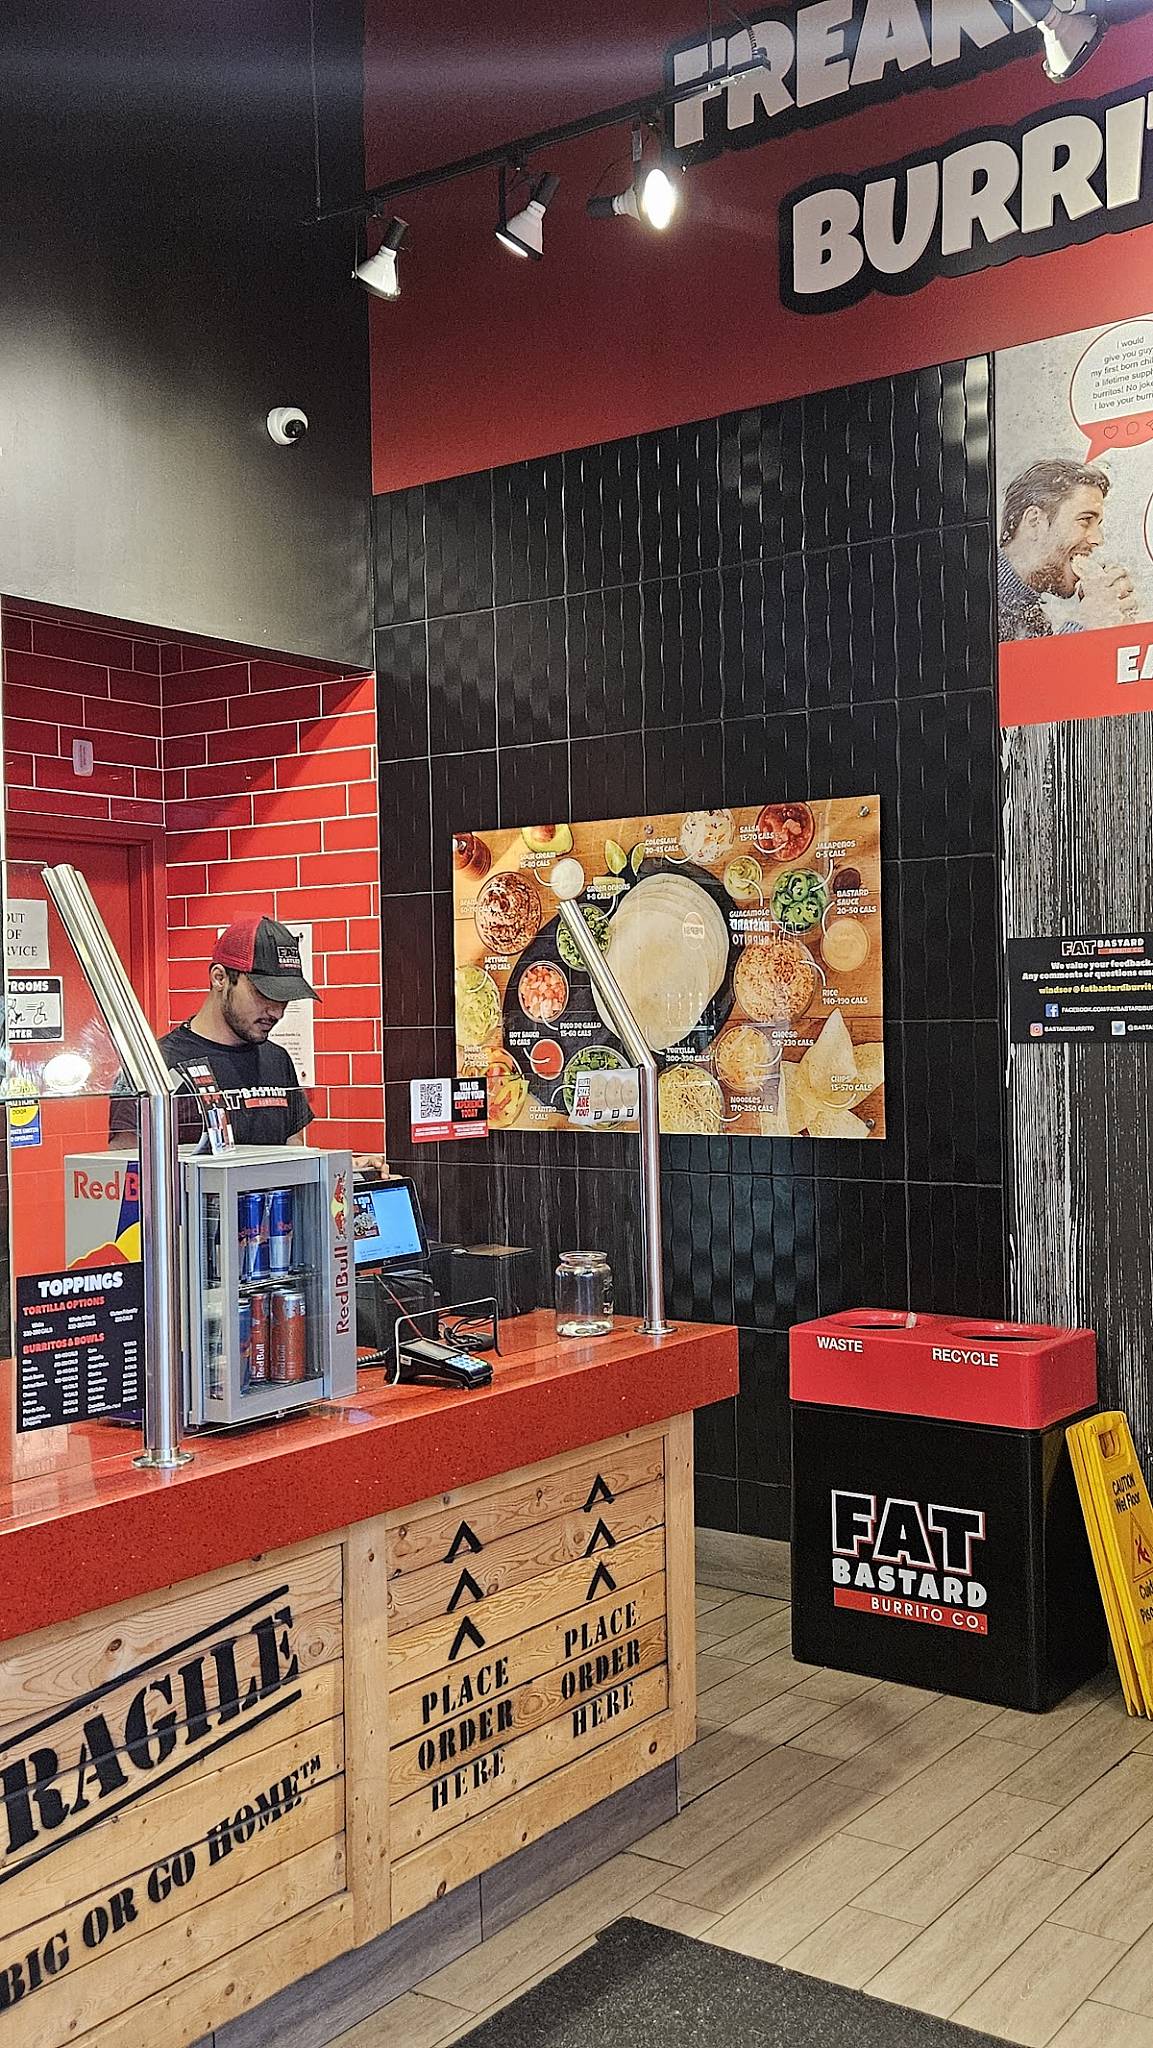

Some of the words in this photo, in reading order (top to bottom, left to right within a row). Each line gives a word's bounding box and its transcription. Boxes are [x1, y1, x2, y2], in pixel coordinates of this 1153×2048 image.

[793, 90, 1153, 293] BURRI
[1121, 337, 1144, 347] would
[1104, 354, 1120, 364] give
[1122, 351, 1137, 360] you
[1091, 369, 1102, 377] my
[1104, 365, 1119, 374] first
[1102, 375, 1129, 386] lifetime
[1093, 386, 1124, 399] burritos!
[1126, 385, 1137, 393] No
[1099, 401, 1114, 409] love
[1117, 396, 1134, 407] your
[740, 826, 760, 834] SALSA
[758, 832, 775, 840] CALS
[829, 849, 846, 858] CALS
[837, 889, 868, 897] BASTARD
[837, 898, 859, 906] SAUCE
[859, 905, 877, 914] CALS
[1061, 940, 1097, 956] FAT
[1097, 938, 1145, 948] BASTARD
[1051, 961, 1064, 970] We
[1065, 961, 1088, 969] value
[1090, 960, 1110, 970] your
[1022, 972, 1039, 981] Any
[1039, 970, 1083, 979] comments
[1094, 968, 1137, 979] questions
[822, 989, 839, 997] RICE
[850, 996, 868, 1005] CALS
[577, 1029, 592, 1037] CALS
[517, 1038, 531, 1046] CALS
[797, 1039, 814, 1047] CALS
[694, 1054, 711, 1062] CALS
[854, 1083, 873, 1091] CALS
[576, 1097, 590, 1108] ARE
[757, 1104, 774, 1112] CALS
[74, 1170, 119, 1200] Red
[334, 1245, 348, 1289] Bull
[38, 1271, 123, 1298] TOPPINGS
[22, 1303, 66, 1316] TORTILLA
[66, 1296, 105, 1309] OPTIONS
[335, 1291, 350, 1335] Red
[22, 1339, 68, 1354] BURRITOS
[74, 1332, 105, 1346] BOWLS
[256, 1343, 265, 1360] Bull
[817, 1336, 863, 1353] WASTE
[932, 1348, 999, 1368] RECYCLE
[256, 1360, 265, 1379] Red
[1111, 1472, 1136, 1497] CAUTION
[1115, 1499, 1128, 1514] Wet
[1126, 1491, 1141, 1510] Floor
[831, 1489, 987, 1577] FAT
[832, 1558, 988, 1608] BASTARD
[871, 1597, 943, 1623] BURRITO
[952, 1612, 985, 1632] CO.
[564, 1600, 638, 1659] PLACE
[561, 1639, 641, 1700] ORDER
[421, 1657, 509, 1725] PLACE
[572, 1681, 634, 1738] HERE
[418, 1699, 513, 1771] ORDER
[432, 1749, 506, 1812] HERE
[82, 1887, 138, 1949] OR
[147, 1851, 196, 1904] GO
